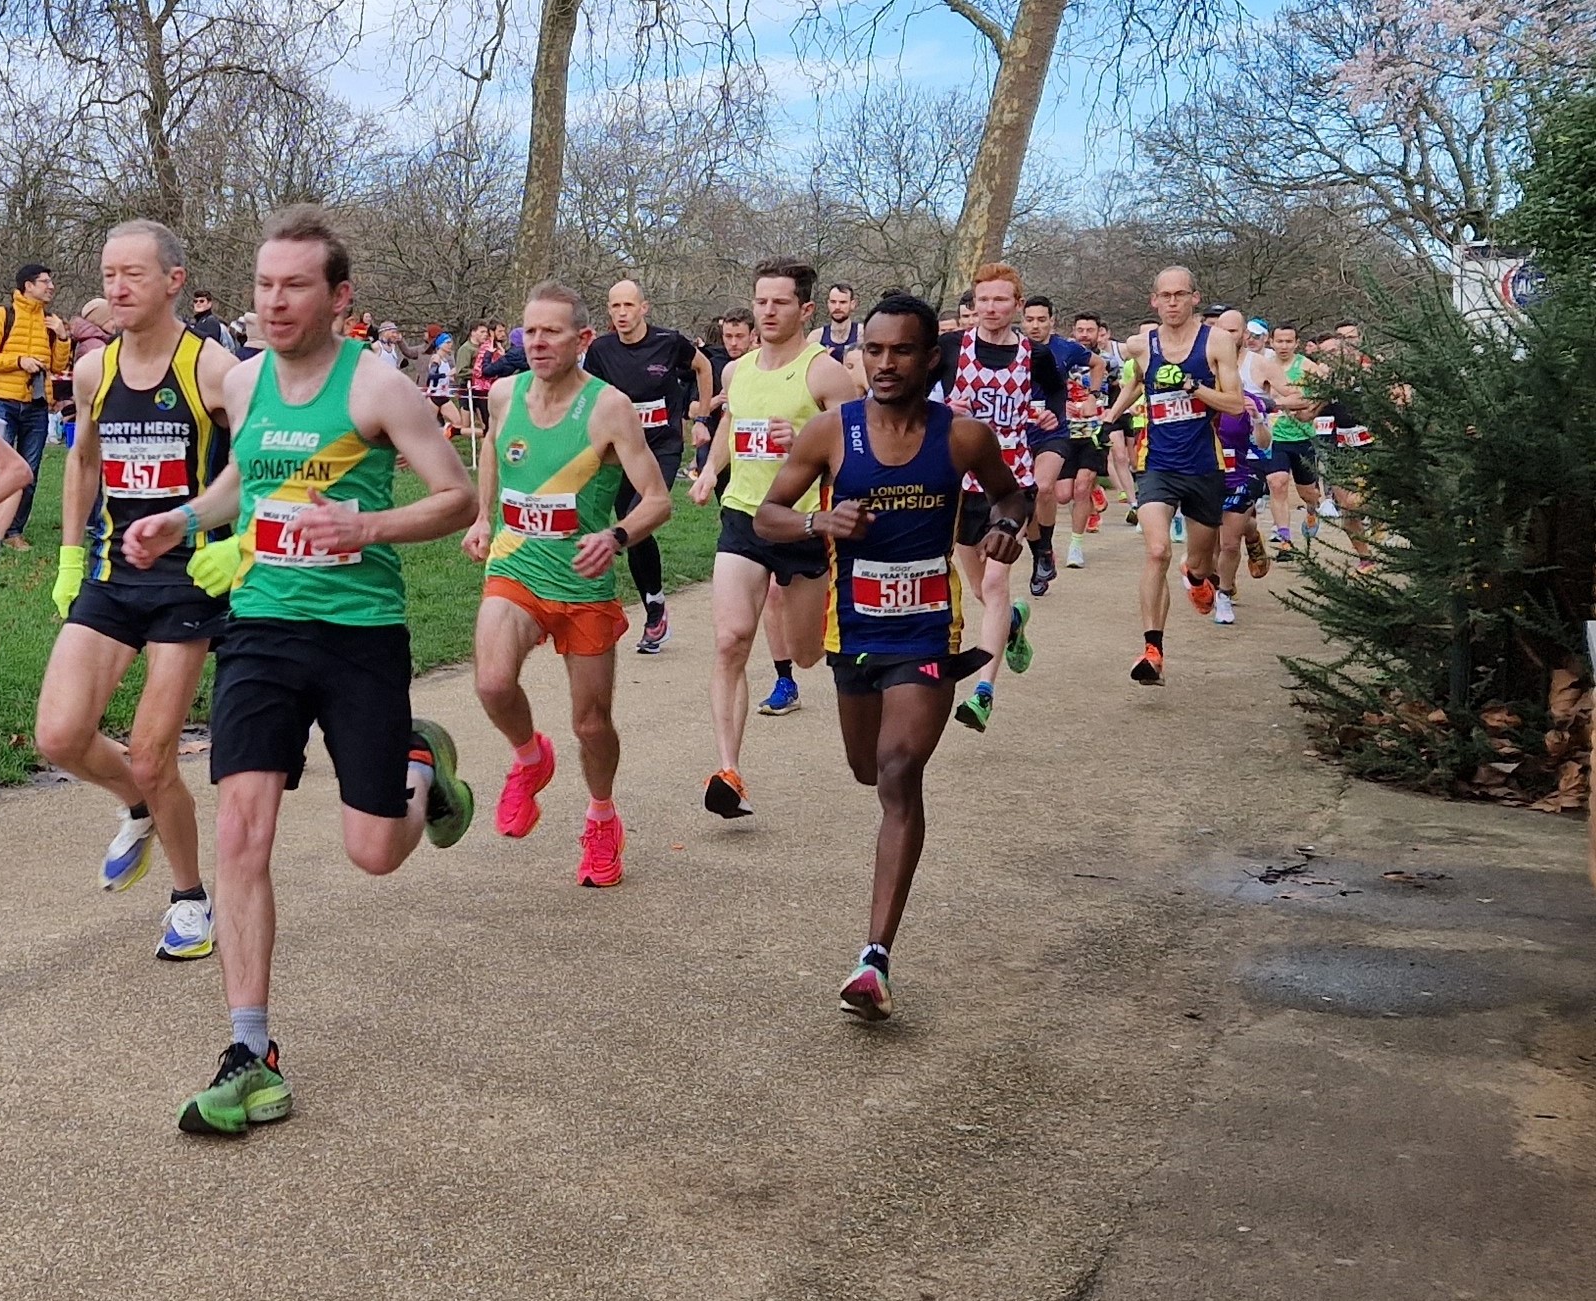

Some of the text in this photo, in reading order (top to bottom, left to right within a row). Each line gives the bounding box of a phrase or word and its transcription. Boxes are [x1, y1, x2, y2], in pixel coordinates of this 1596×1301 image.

[973, 386, 1015, 427] SU
[1165, 399, 1193, 417] 540
[99, 421, 190, 436] NORTH HERTS
[261, 430, 321, 447] EALING
[851, 425, 864, 454] soar
[747, 432, 767, 453] 43
[121, 461, 161, 489] 457
[248, 458, 331, 481] JONATHAN
[870, 484, 923, 497] LONDON
[849, 495, 945, 511] EATHSIDE
[519, 508, 553, 532] 437
[880, 578, 921, 607] 581
